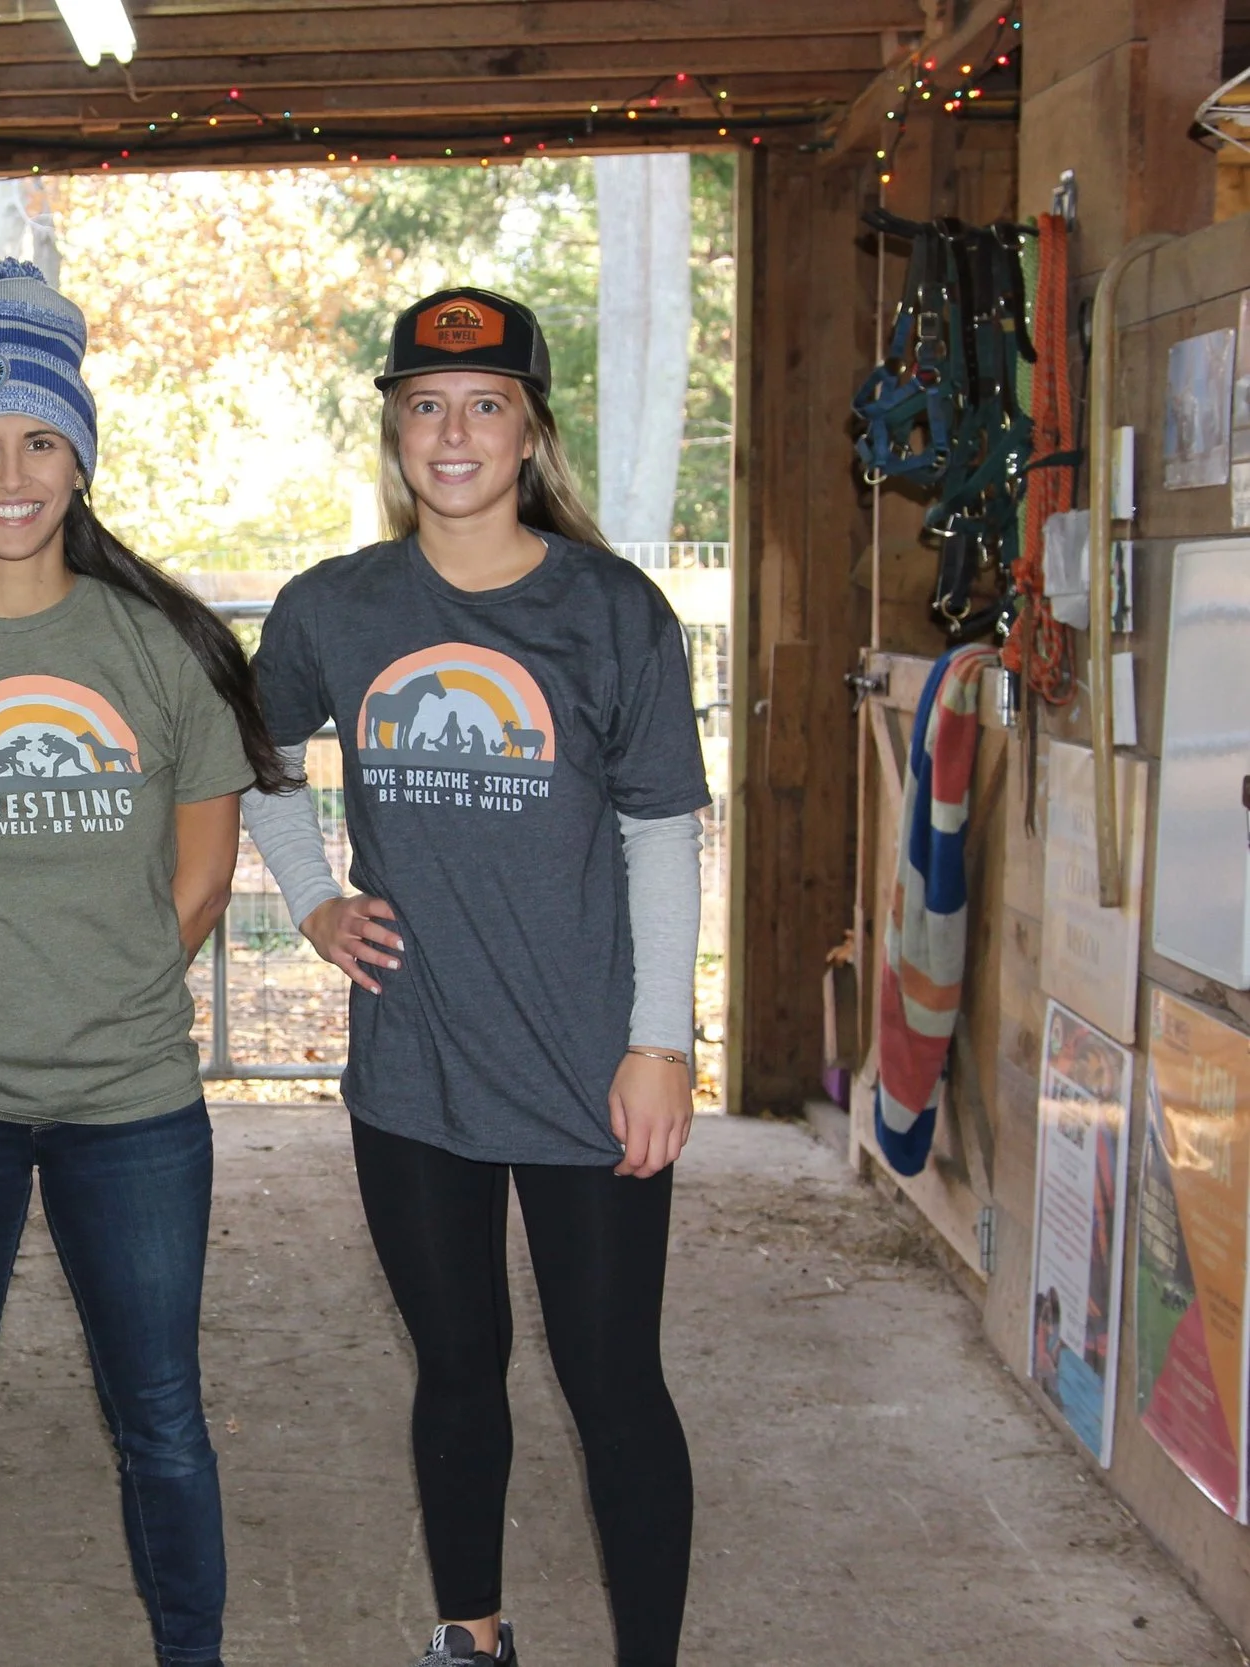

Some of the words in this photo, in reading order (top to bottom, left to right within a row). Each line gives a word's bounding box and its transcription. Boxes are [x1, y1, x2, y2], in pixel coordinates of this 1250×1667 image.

[406, 770, 469, 790] BREATHE
[484, 776, 549, 798] STRETCH
[378, 788, 397, 802] BE
[402, 789, 441, 804] WELL
[455, 793, 472, 807] BE
[479, 795, 523, 812] WILD
[53, 819, 73, 833] BE
[81, 817, 125, 832] WILD
